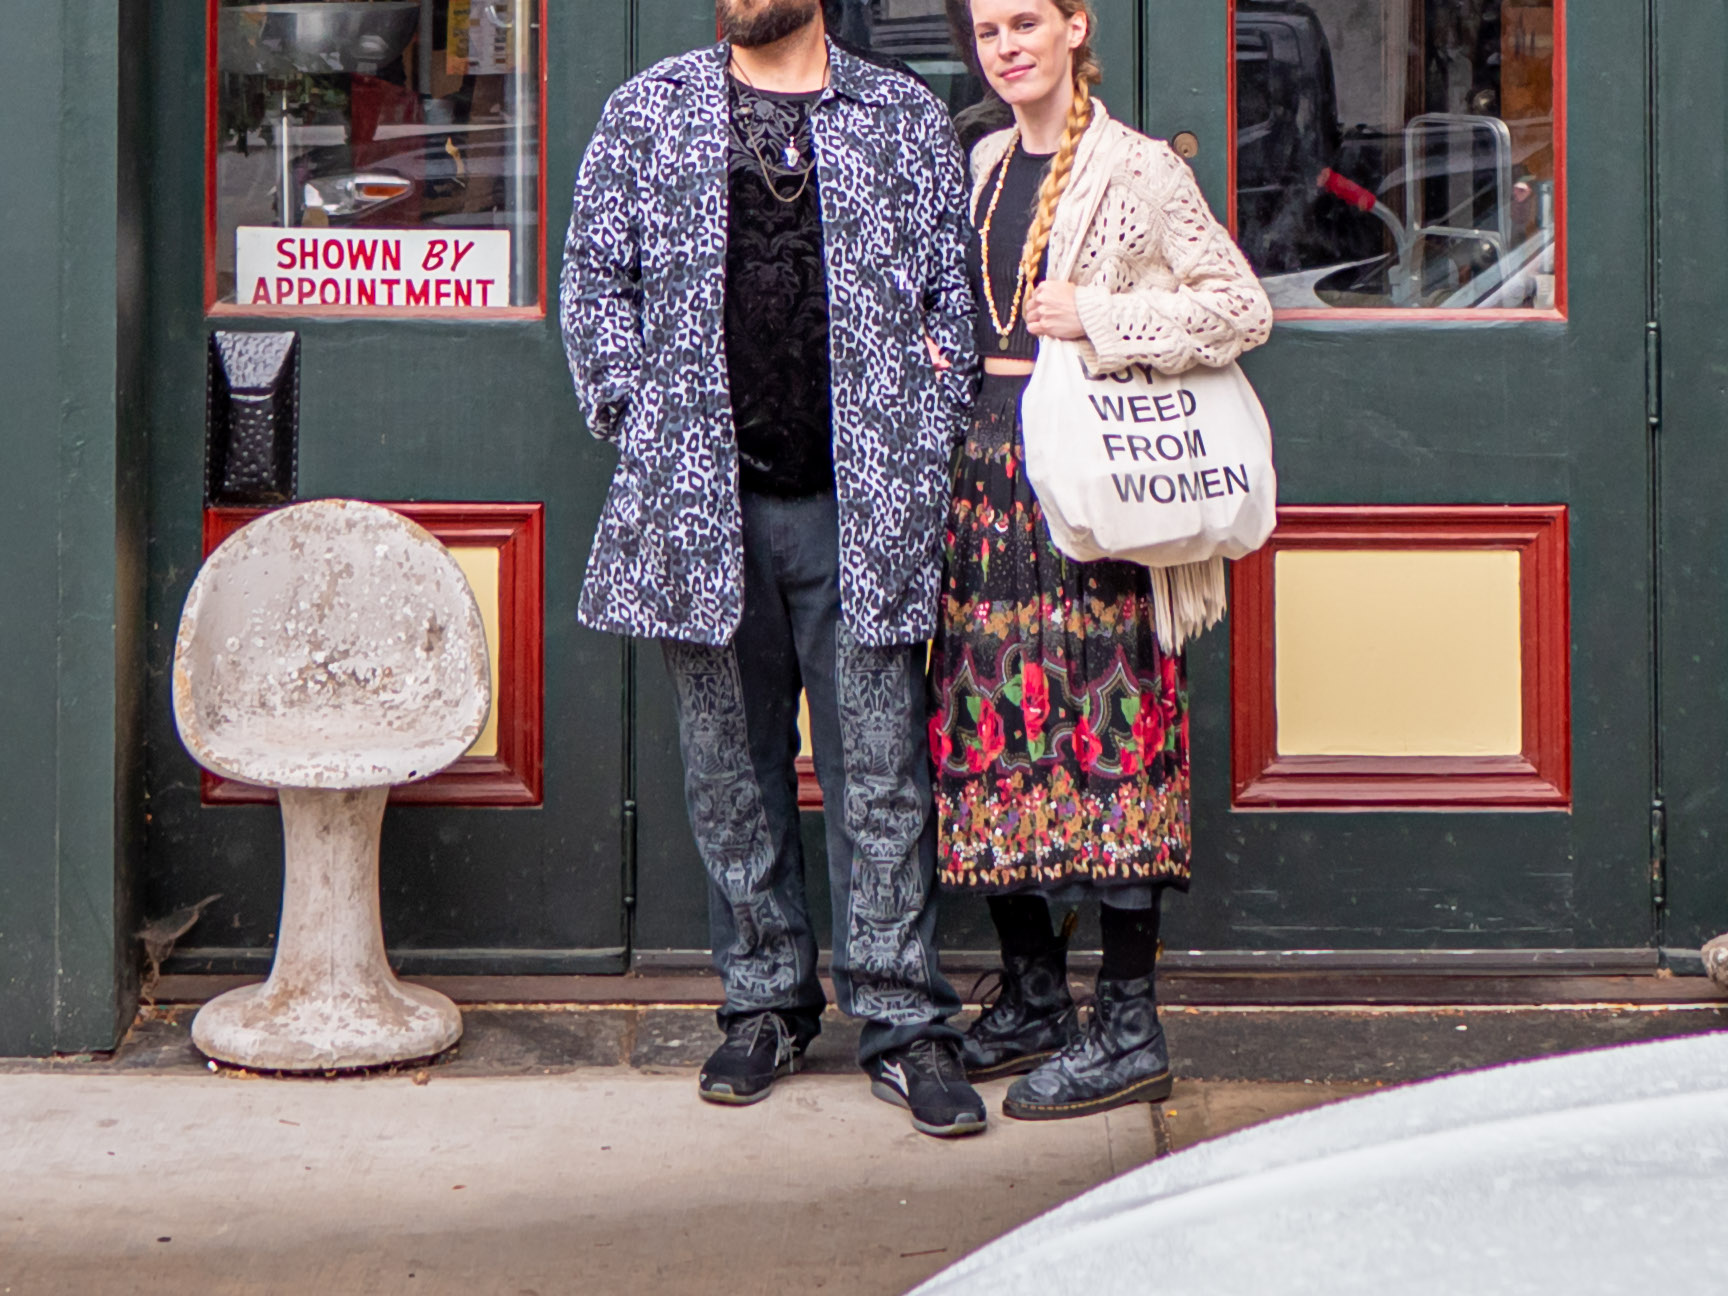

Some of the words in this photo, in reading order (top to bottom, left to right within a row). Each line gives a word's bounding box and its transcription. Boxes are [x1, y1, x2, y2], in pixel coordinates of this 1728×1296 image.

[276, 237, 401, 271] SHOWN
[421, 239, 475, 272] BY
[251, 276, 495, 306] APPOINTMENT
[1088, 389, 1197, 423] WEED
[1102, 429, 1207, 461] FROM
[1111, 464, 1250, 504] WOMEN
